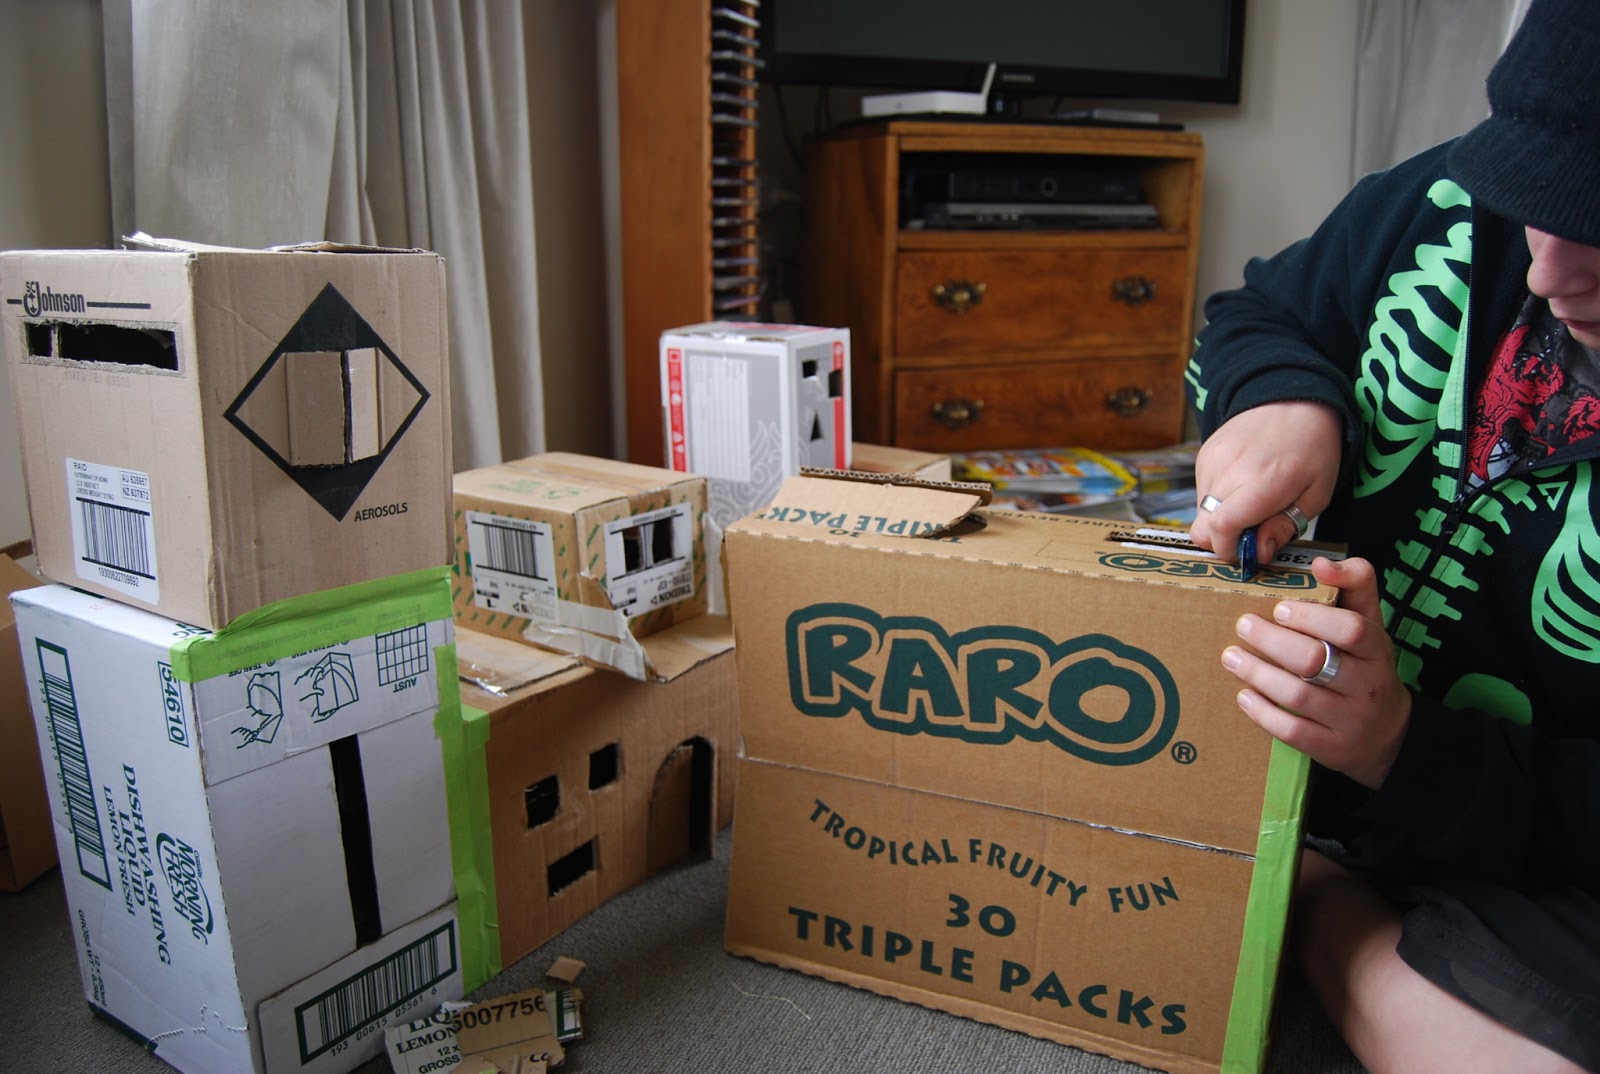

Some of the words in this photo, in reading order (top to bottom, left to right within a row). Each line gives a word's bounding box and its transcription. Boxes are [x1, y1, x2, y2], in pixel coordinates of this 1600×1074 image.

[23, 281, 86, 318] Johnson
[73, 462, 88, 472] RAID
[122, 487, 130, 497] NZ
[354, 501, 408, 522] AEROSOLS
[161, 666, 185, 742] 54610
[392, 676, 418, 693] AUST
[787, 604, 1179, 765] RARO
[103, 784, 123, 853] LEMON
[117, 856, 136, 917] FRESH
[119, 809, 146, 907] LIQUID
[122, 762, 172, 966] DISHWASHING
[809, 798, 959, 866] TROPICAL
[969, 838, 1088, 907] FRUITY
[1108, 876, 1180, 913] FUN
[164, 844, 190, 921] FRESH
[175, 838, 208, 945] MORNING
[78, 908, 91, 948] GROSS
[946, 893, 1017, 938] 30
[788, 907, 975, 984] TRIPLE
[1000, 959, 1187, 1036] PACKS
[330, 1040, 349, 1057] 193
[356, 1017, 388, 1041] 00615
[395, 995, 424, 1018] 05561
[431, 986, 437, 995] 6
[395, 1026, 458, 1055] LEMON
[418, 1054, 460, 1074] GROSS
[436, 1046, 451, 1057] 12
